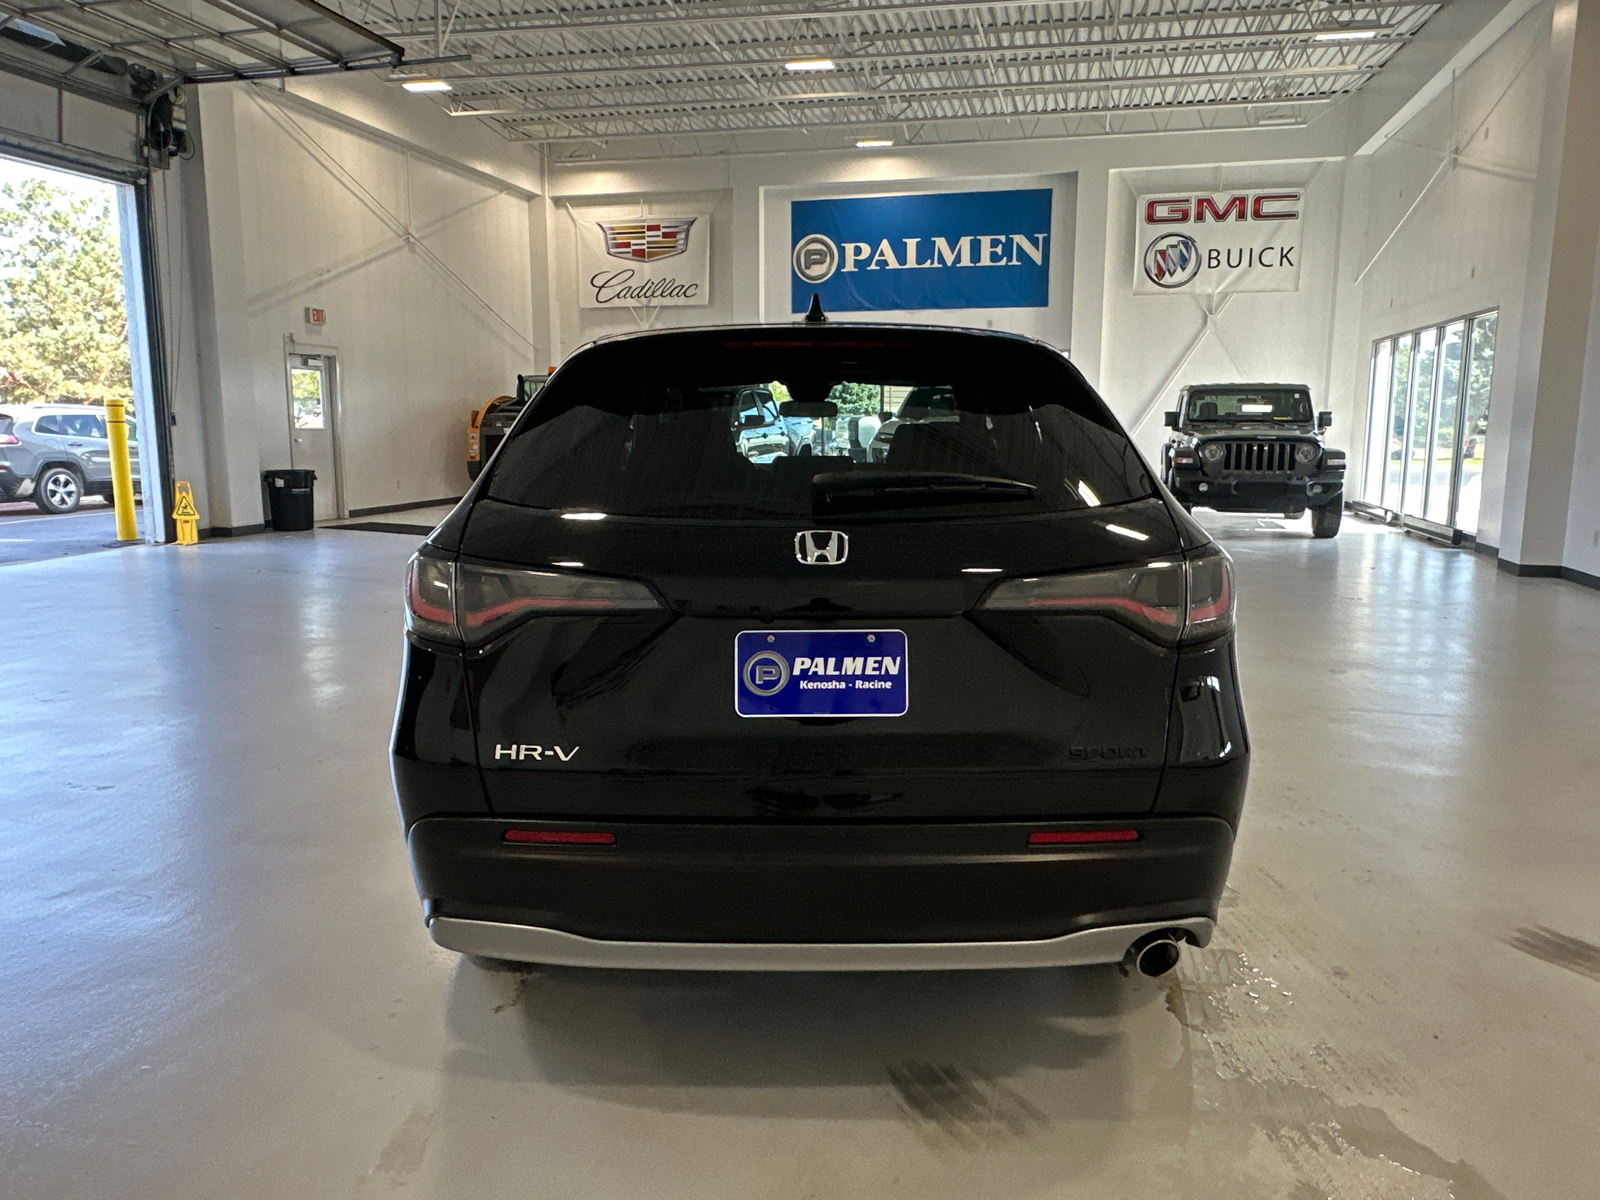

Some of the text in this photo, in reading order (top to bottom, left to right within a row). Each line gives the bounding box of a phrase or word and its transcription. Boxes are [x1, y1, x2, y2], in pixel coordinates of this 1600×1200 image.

[1145, 192, 1300, 225] GMC
[841, 233, 1048, 272] PALMEN
[1207, 246, 1295, 269] BUICK
[590, 268, 698, 304] Cadillac
[792, 656, 901, 676] PALMEN
[800, 679, 846, 690] Kenosha
[855, 679, 893, 690] Racine
[494, 743, 580, 762] HR-V
